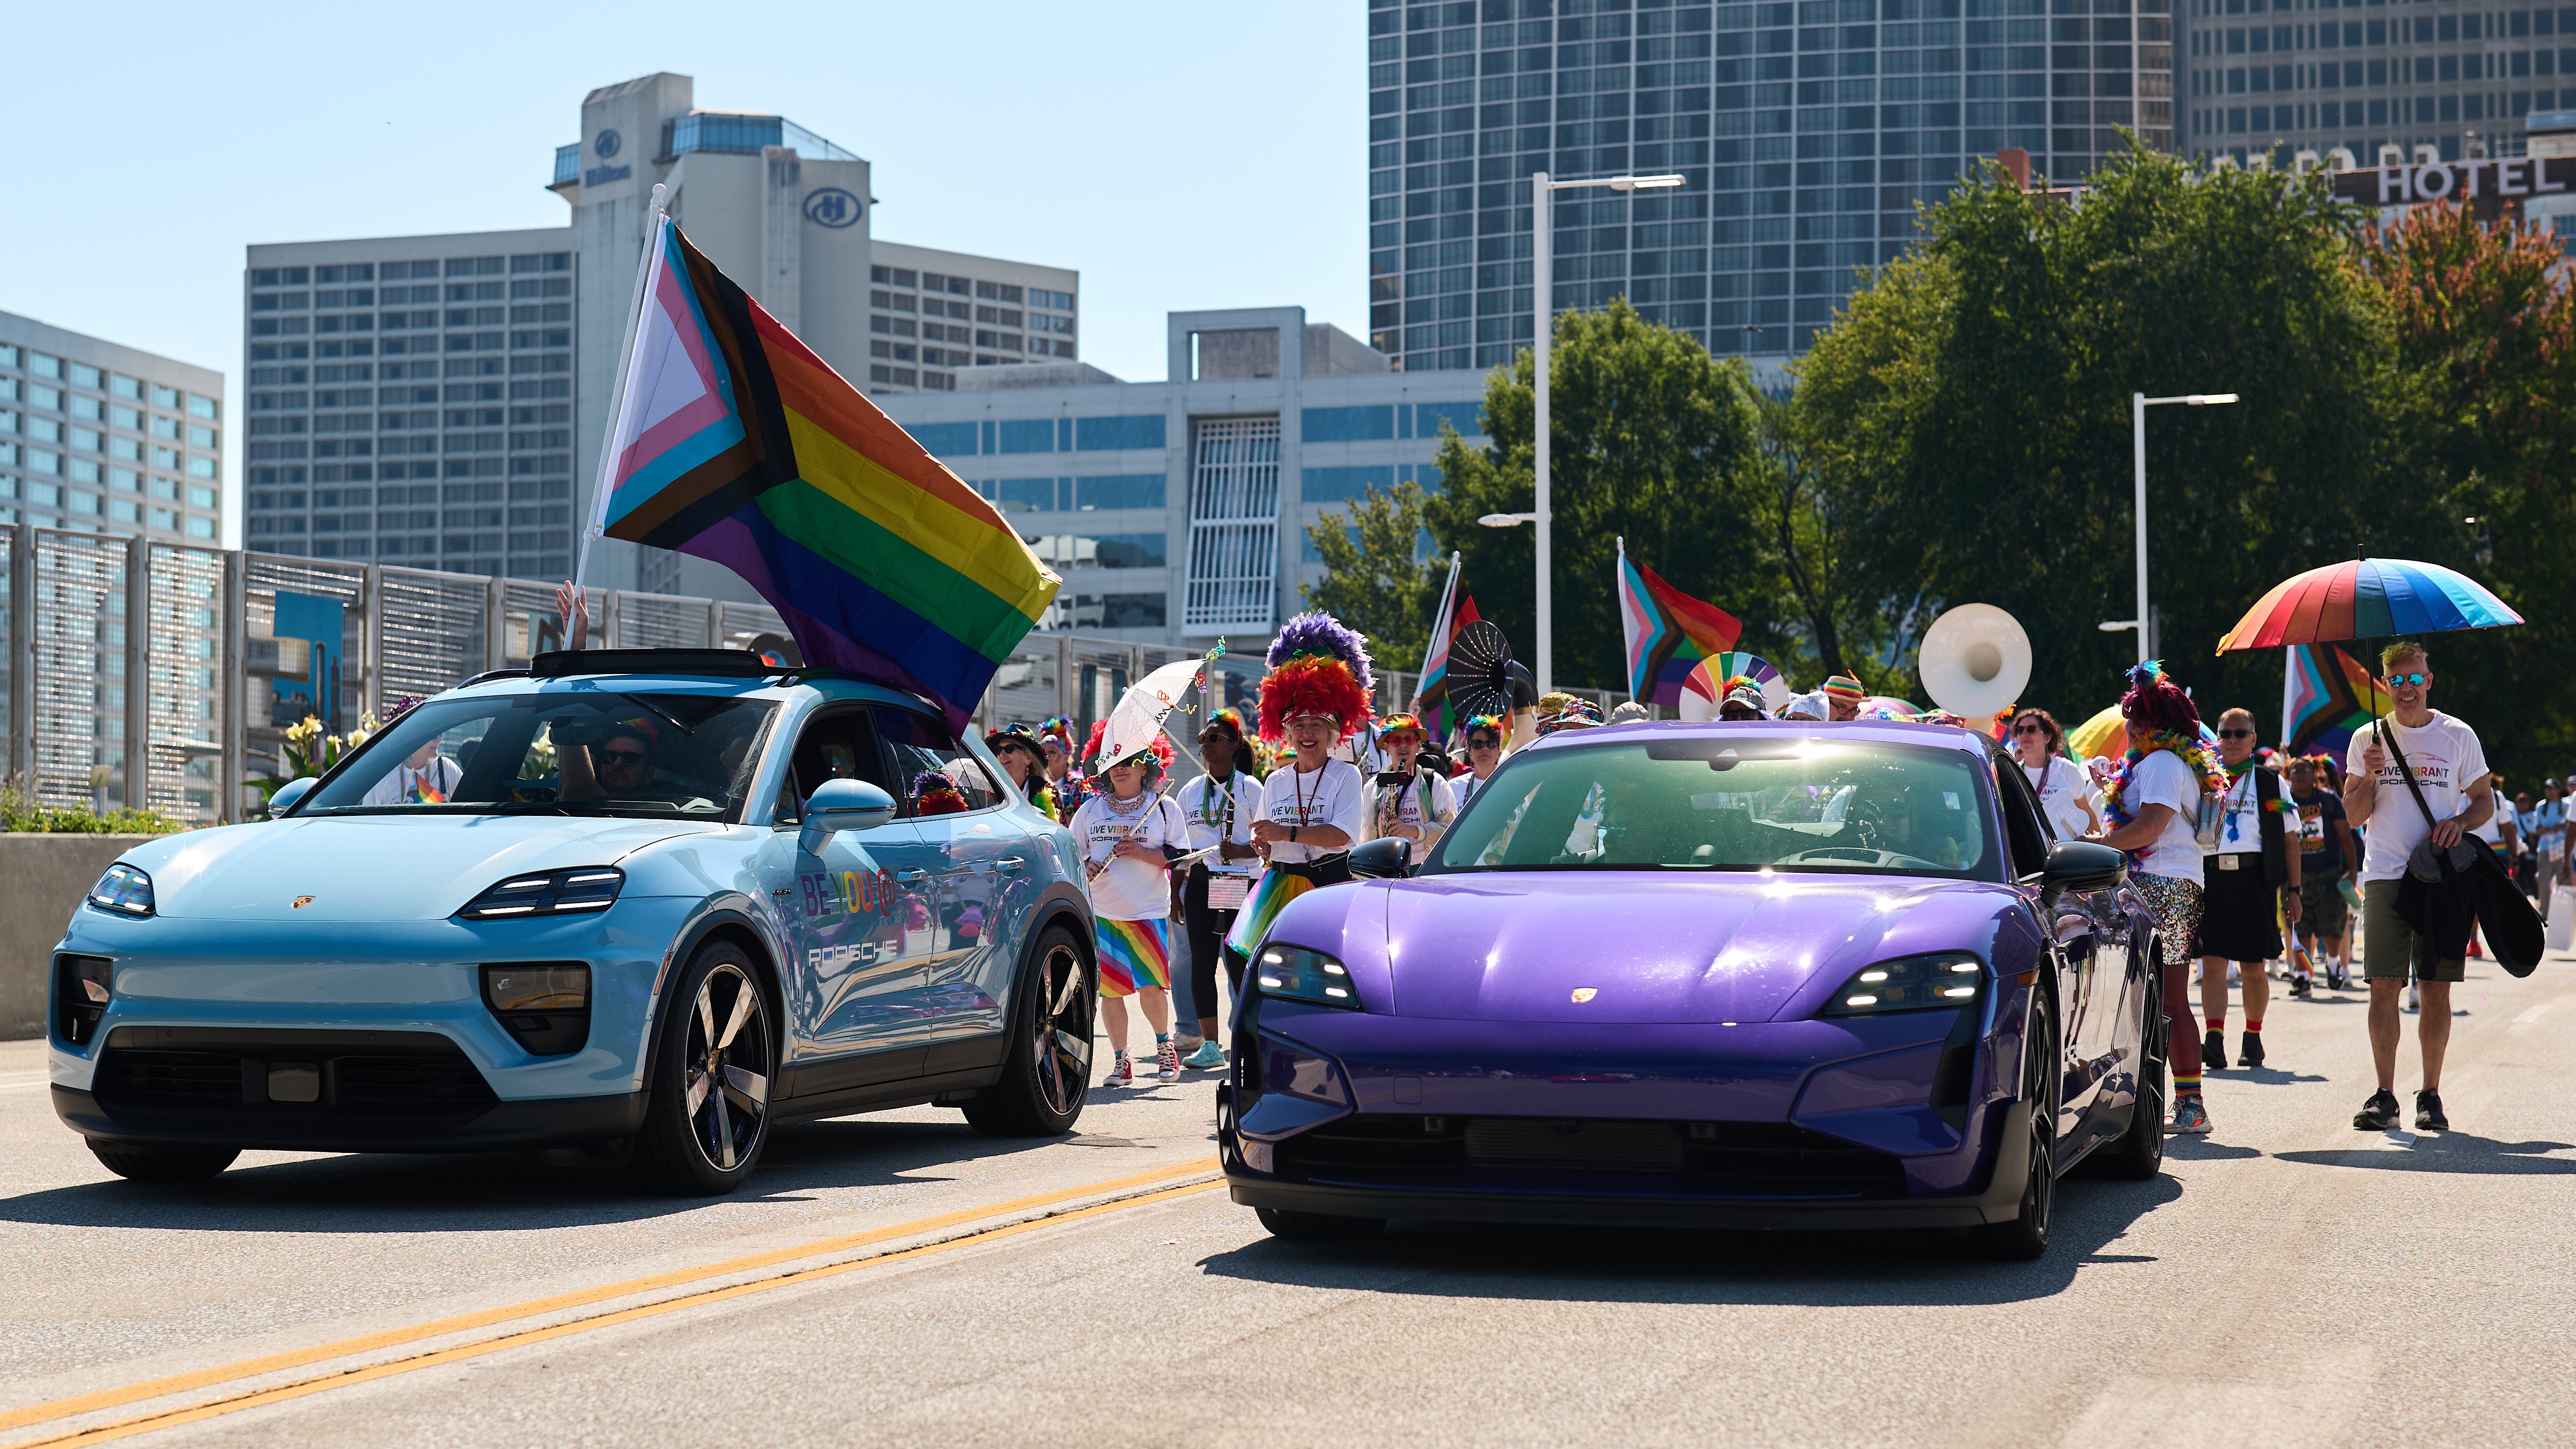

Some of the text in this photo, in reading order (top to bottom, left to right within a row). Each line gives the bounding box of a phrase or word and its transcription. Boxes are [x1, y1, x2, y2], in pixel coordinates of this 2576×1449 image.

[2379, 158, 2566, 204] HOTEL
[2409, 766, 2449, 778] IBRANT
[1090, 825, 1106, 835] LIVE
[800, 868, 897, 917] BE YOU @
[809, 939, 898, 967] PORSCHE
